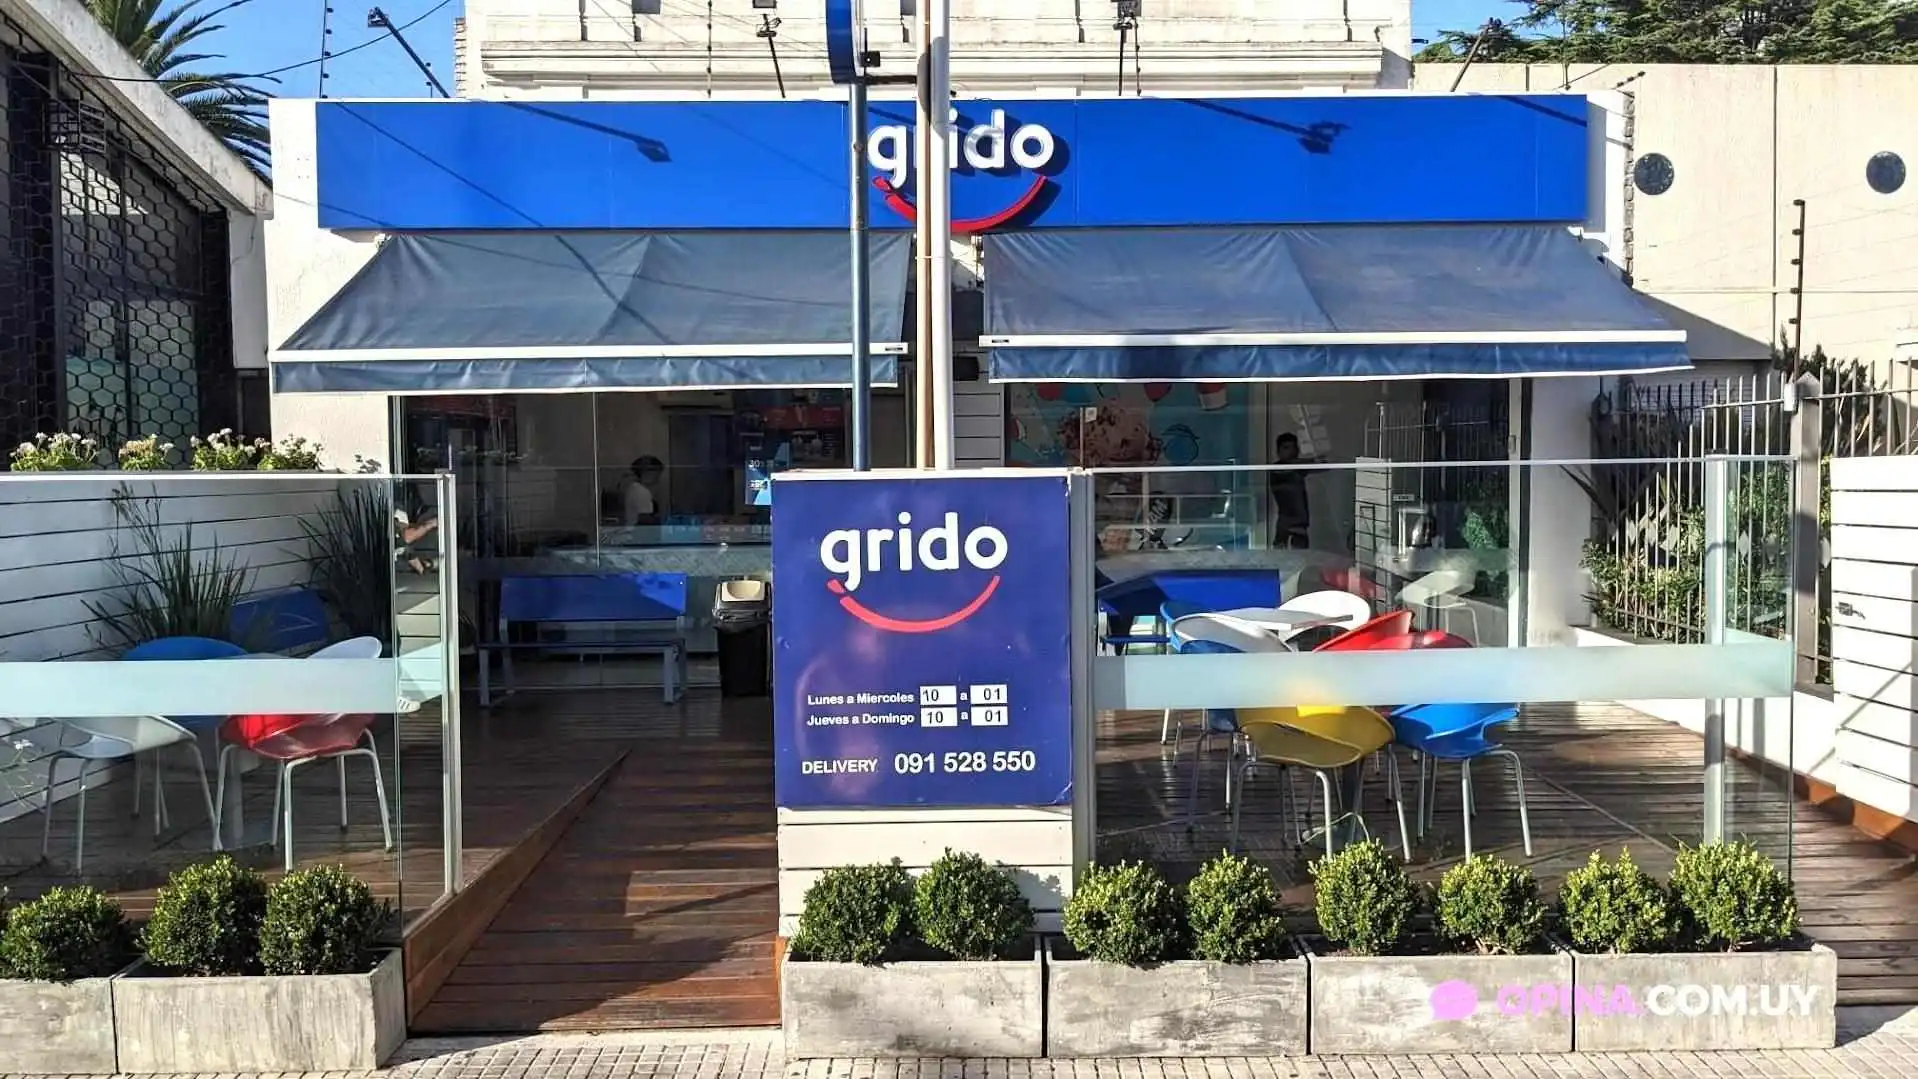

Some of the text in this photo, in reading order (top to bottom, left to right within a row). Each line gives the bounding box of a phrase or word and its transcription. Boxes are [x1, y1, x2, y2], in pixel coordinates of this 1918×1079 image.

[867, 108, 1055, 189] gido
[820, 511, 1008, 592] grido
[807, 693, 844, 706] Lunes
[856, 692, 914, 704] Miercoles
[923, 689, 939, 702] 10
[983, 688, 1001, 701] 01
[807, 714, 849, 726] Jueves
[862, 712, 915, 725] Domingo
[927, 711, 943, 724] 10
[960, 712, 968, 720] a
[984, 710, 1002, 722] 01
[802, 750, 1036, 774] DELIVERY 091 528 550
